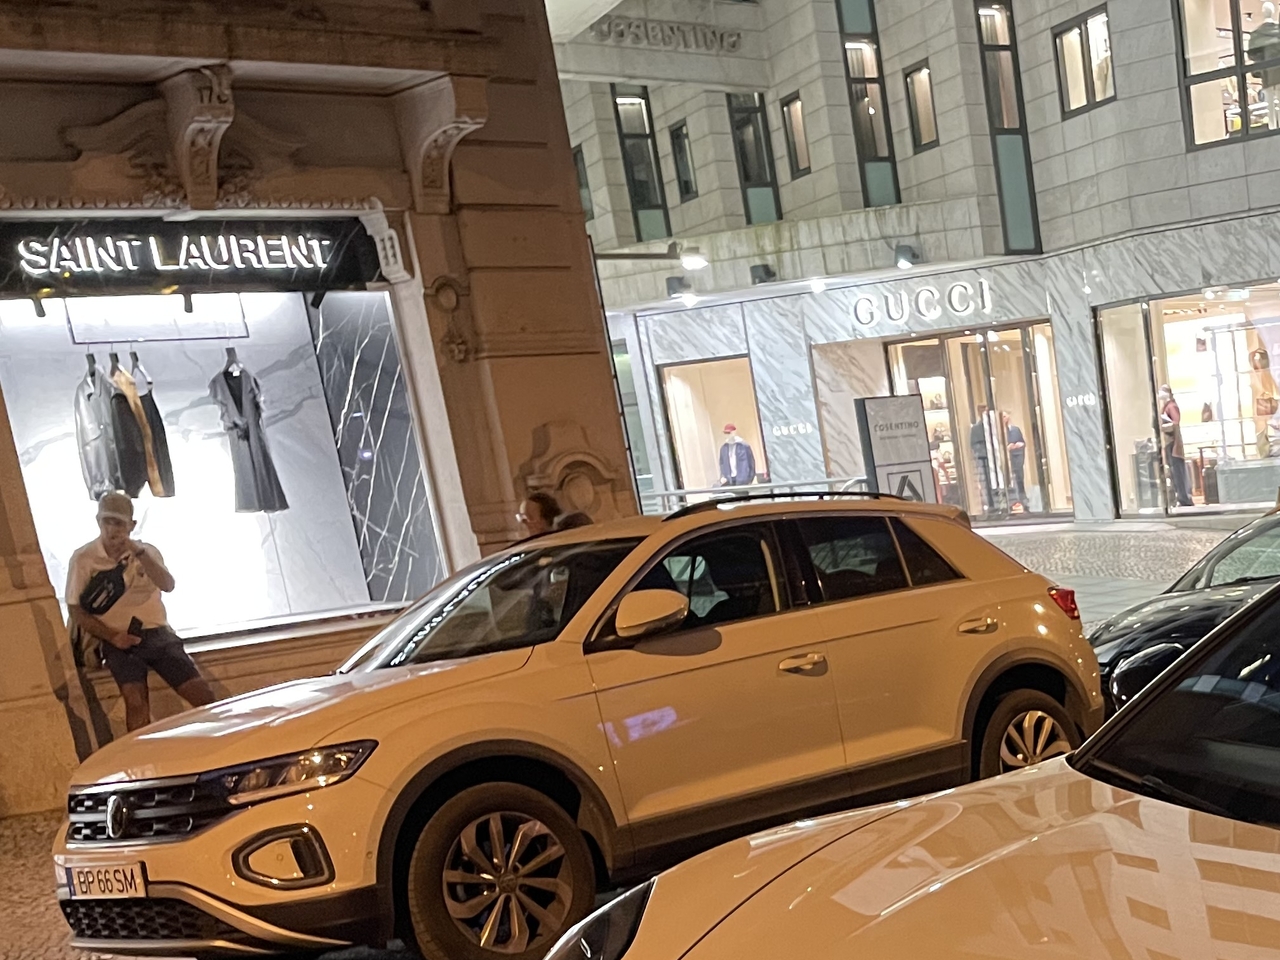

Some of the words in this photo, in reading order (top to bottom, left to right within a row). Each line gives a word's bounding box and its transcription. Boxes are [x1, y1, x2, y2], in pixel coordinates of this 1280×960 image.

[18, 236, 141, 274] SAINT
[149, 234, 330, 271] LAURENT
[852, 278, 993, 329] GUCCI
[772, 422, 813, 437] GUCCI
[873, 421, 919, 433] COSENTINO
